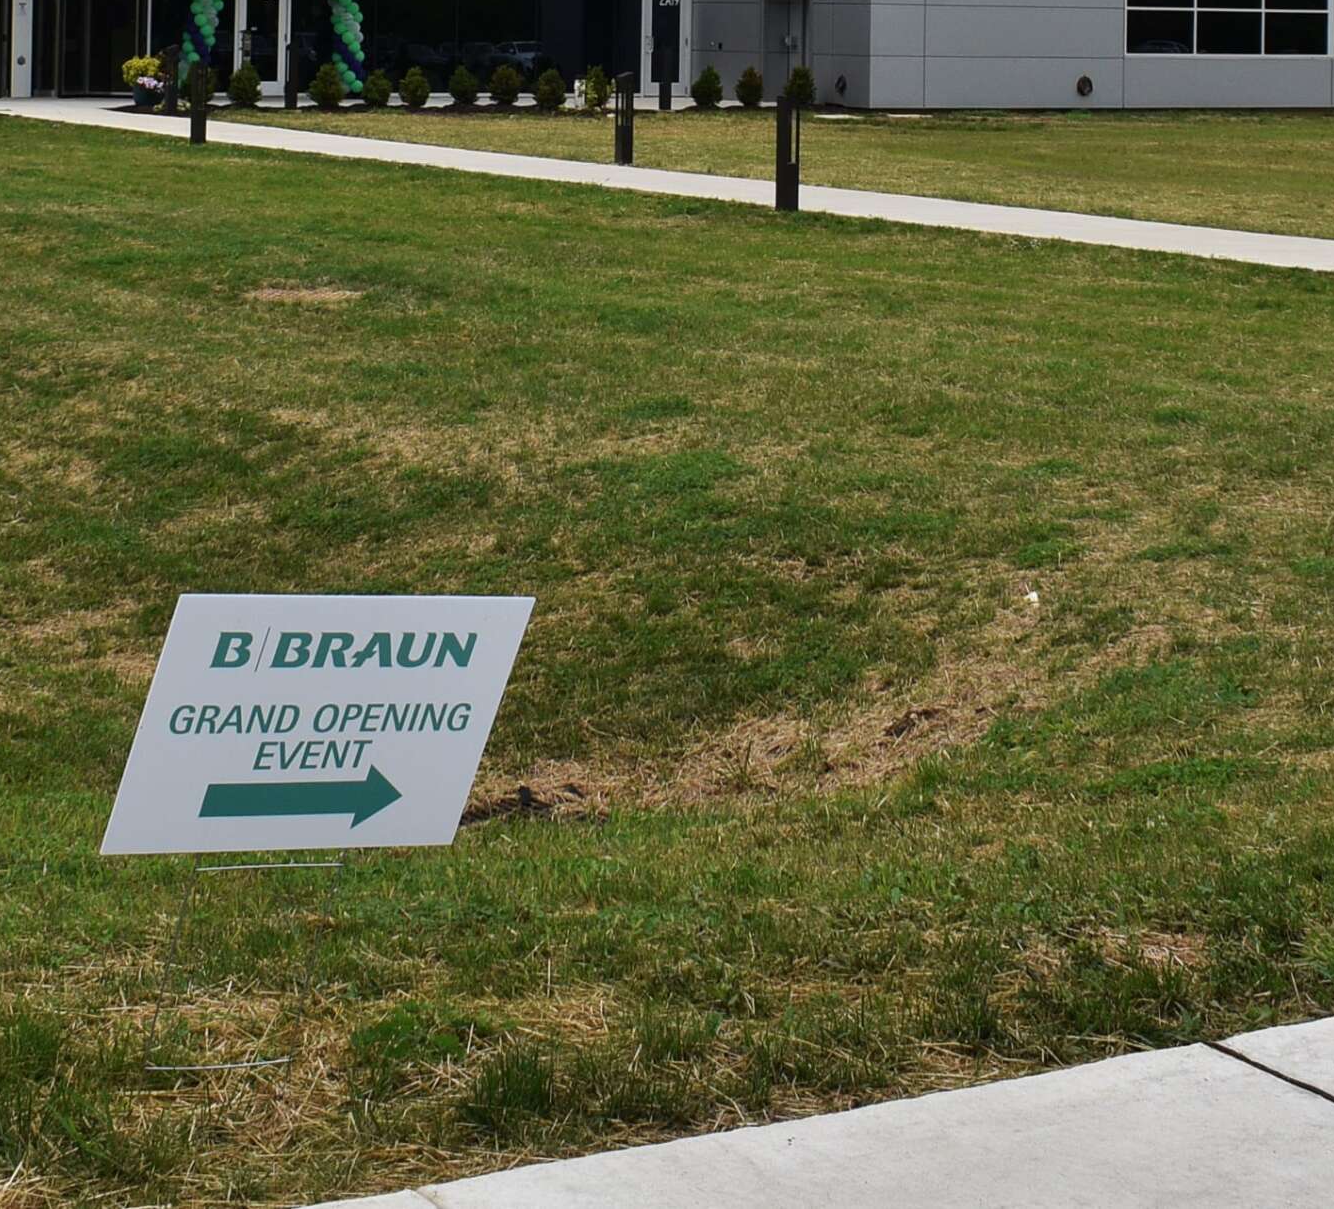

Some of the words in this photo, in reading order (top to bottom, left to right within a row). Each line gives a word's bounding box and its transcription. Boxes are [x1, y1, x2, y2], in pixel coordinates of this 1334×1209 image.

[209, 631, 254, 669] B
[269, 631, 478, 669] BRAUN
[169, 704, 301, 735] GRAND
[313, 702, 472, 733] OPENING
[252, 739, 373, 771] EVENT
